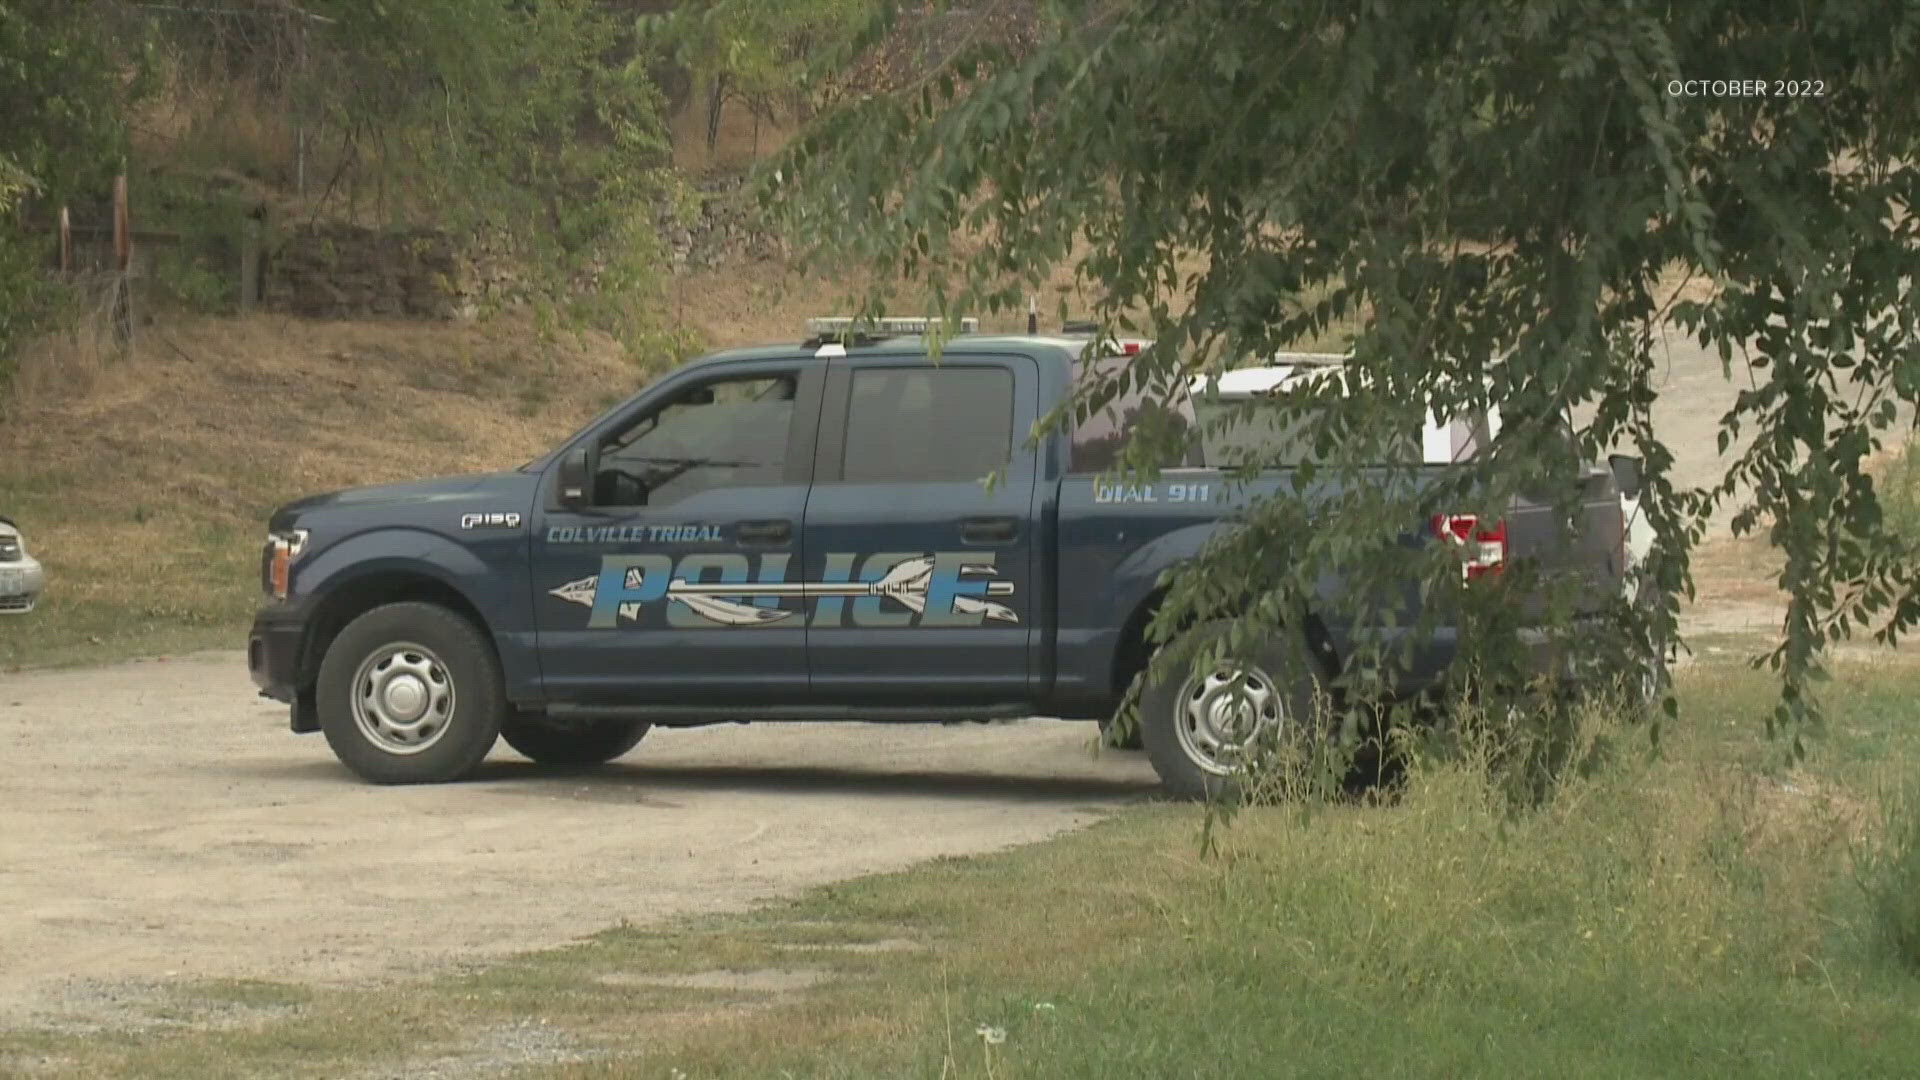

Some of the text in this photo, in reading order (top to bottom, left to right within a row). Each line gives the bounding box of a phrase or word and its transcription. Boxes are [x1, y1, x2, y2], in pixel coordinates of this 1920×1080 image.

[1095, 484, 1209, 504] DIAL 911
[547, 525, 723, 543] COLVILLE TRIBAL
[587, 552, 998, 627] POLICE
